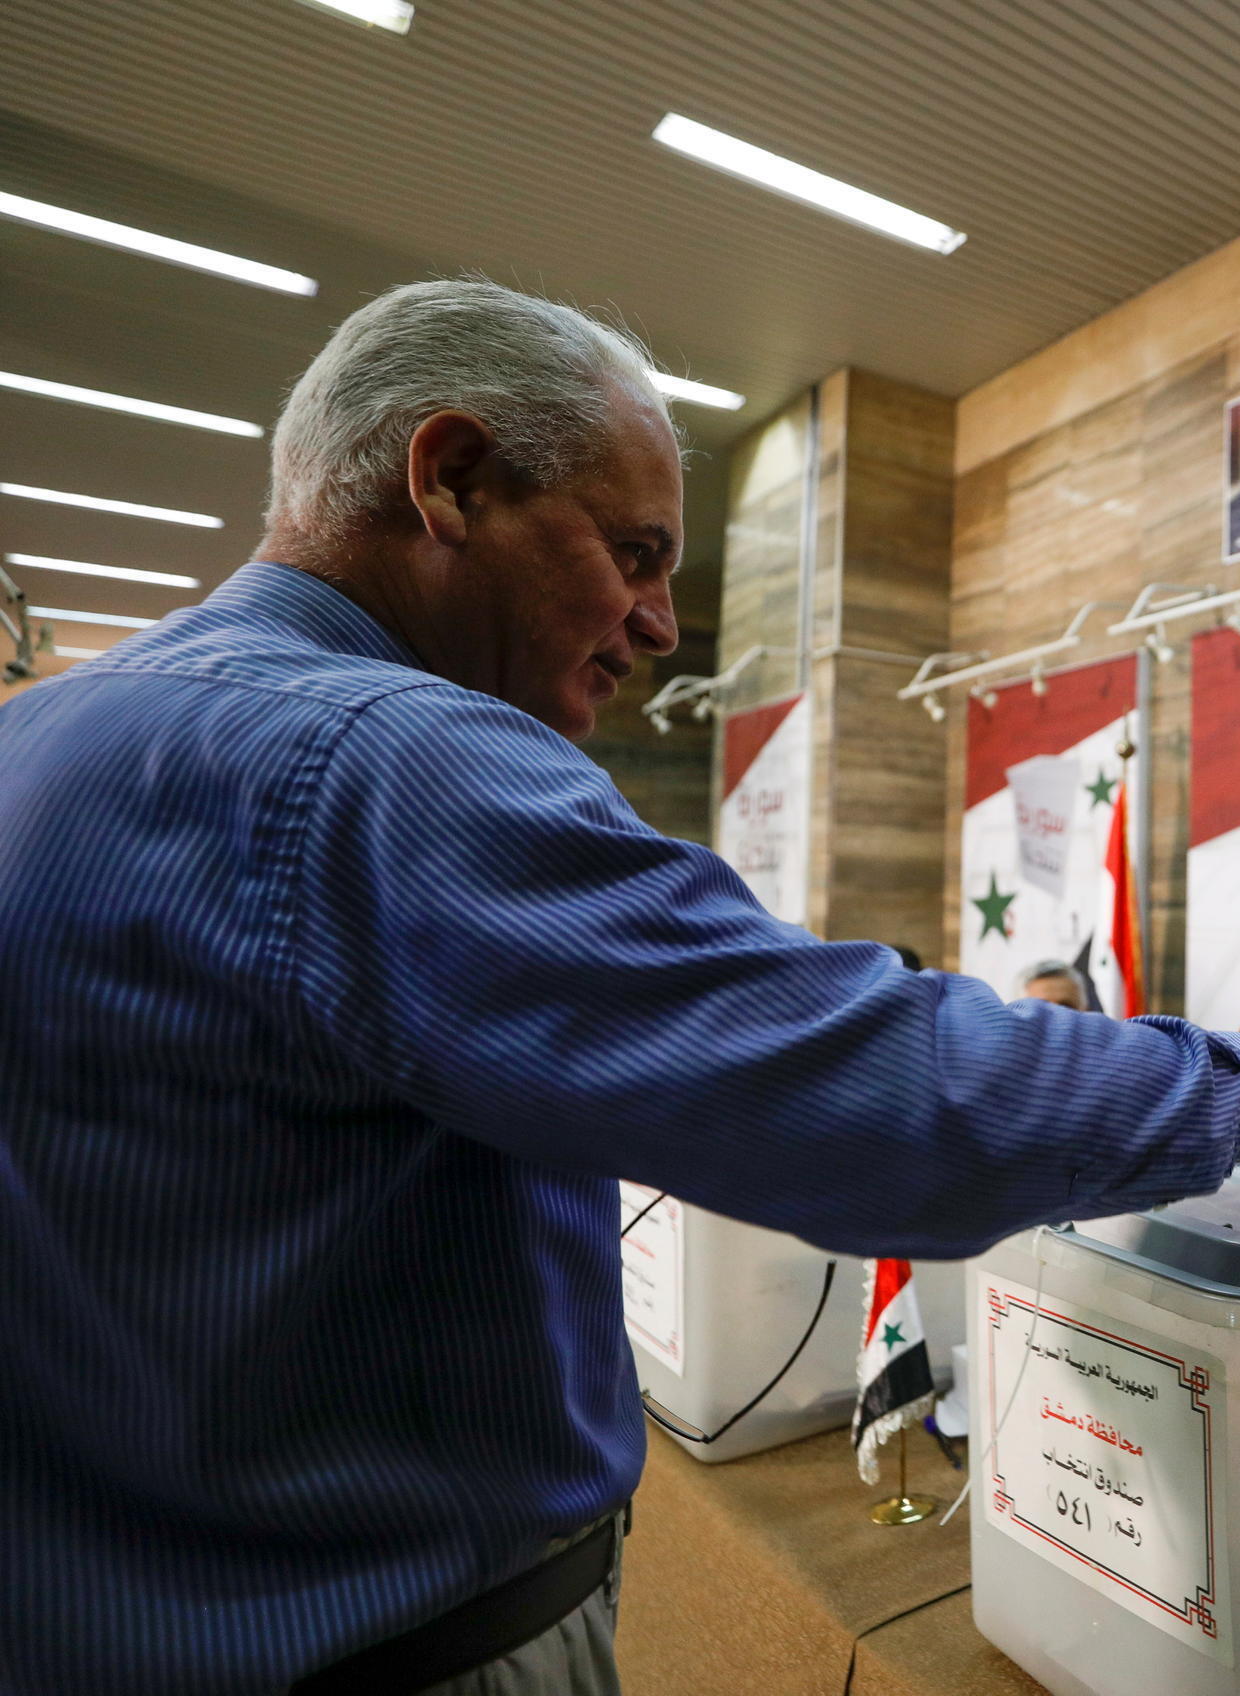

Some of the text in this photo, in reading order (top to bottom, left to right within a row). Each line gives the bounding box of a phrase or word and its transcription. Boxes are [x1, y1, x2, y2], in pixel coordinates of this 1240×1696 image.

[1065, 1347, 1103, 1377] العربية
[1105, 1365, 1159, 1402] الجمهورية
[1040, 1396, 1144, 1456] محافظة دمشق
[1042, 1447, 1145, 1507] صندوق انتخاب
